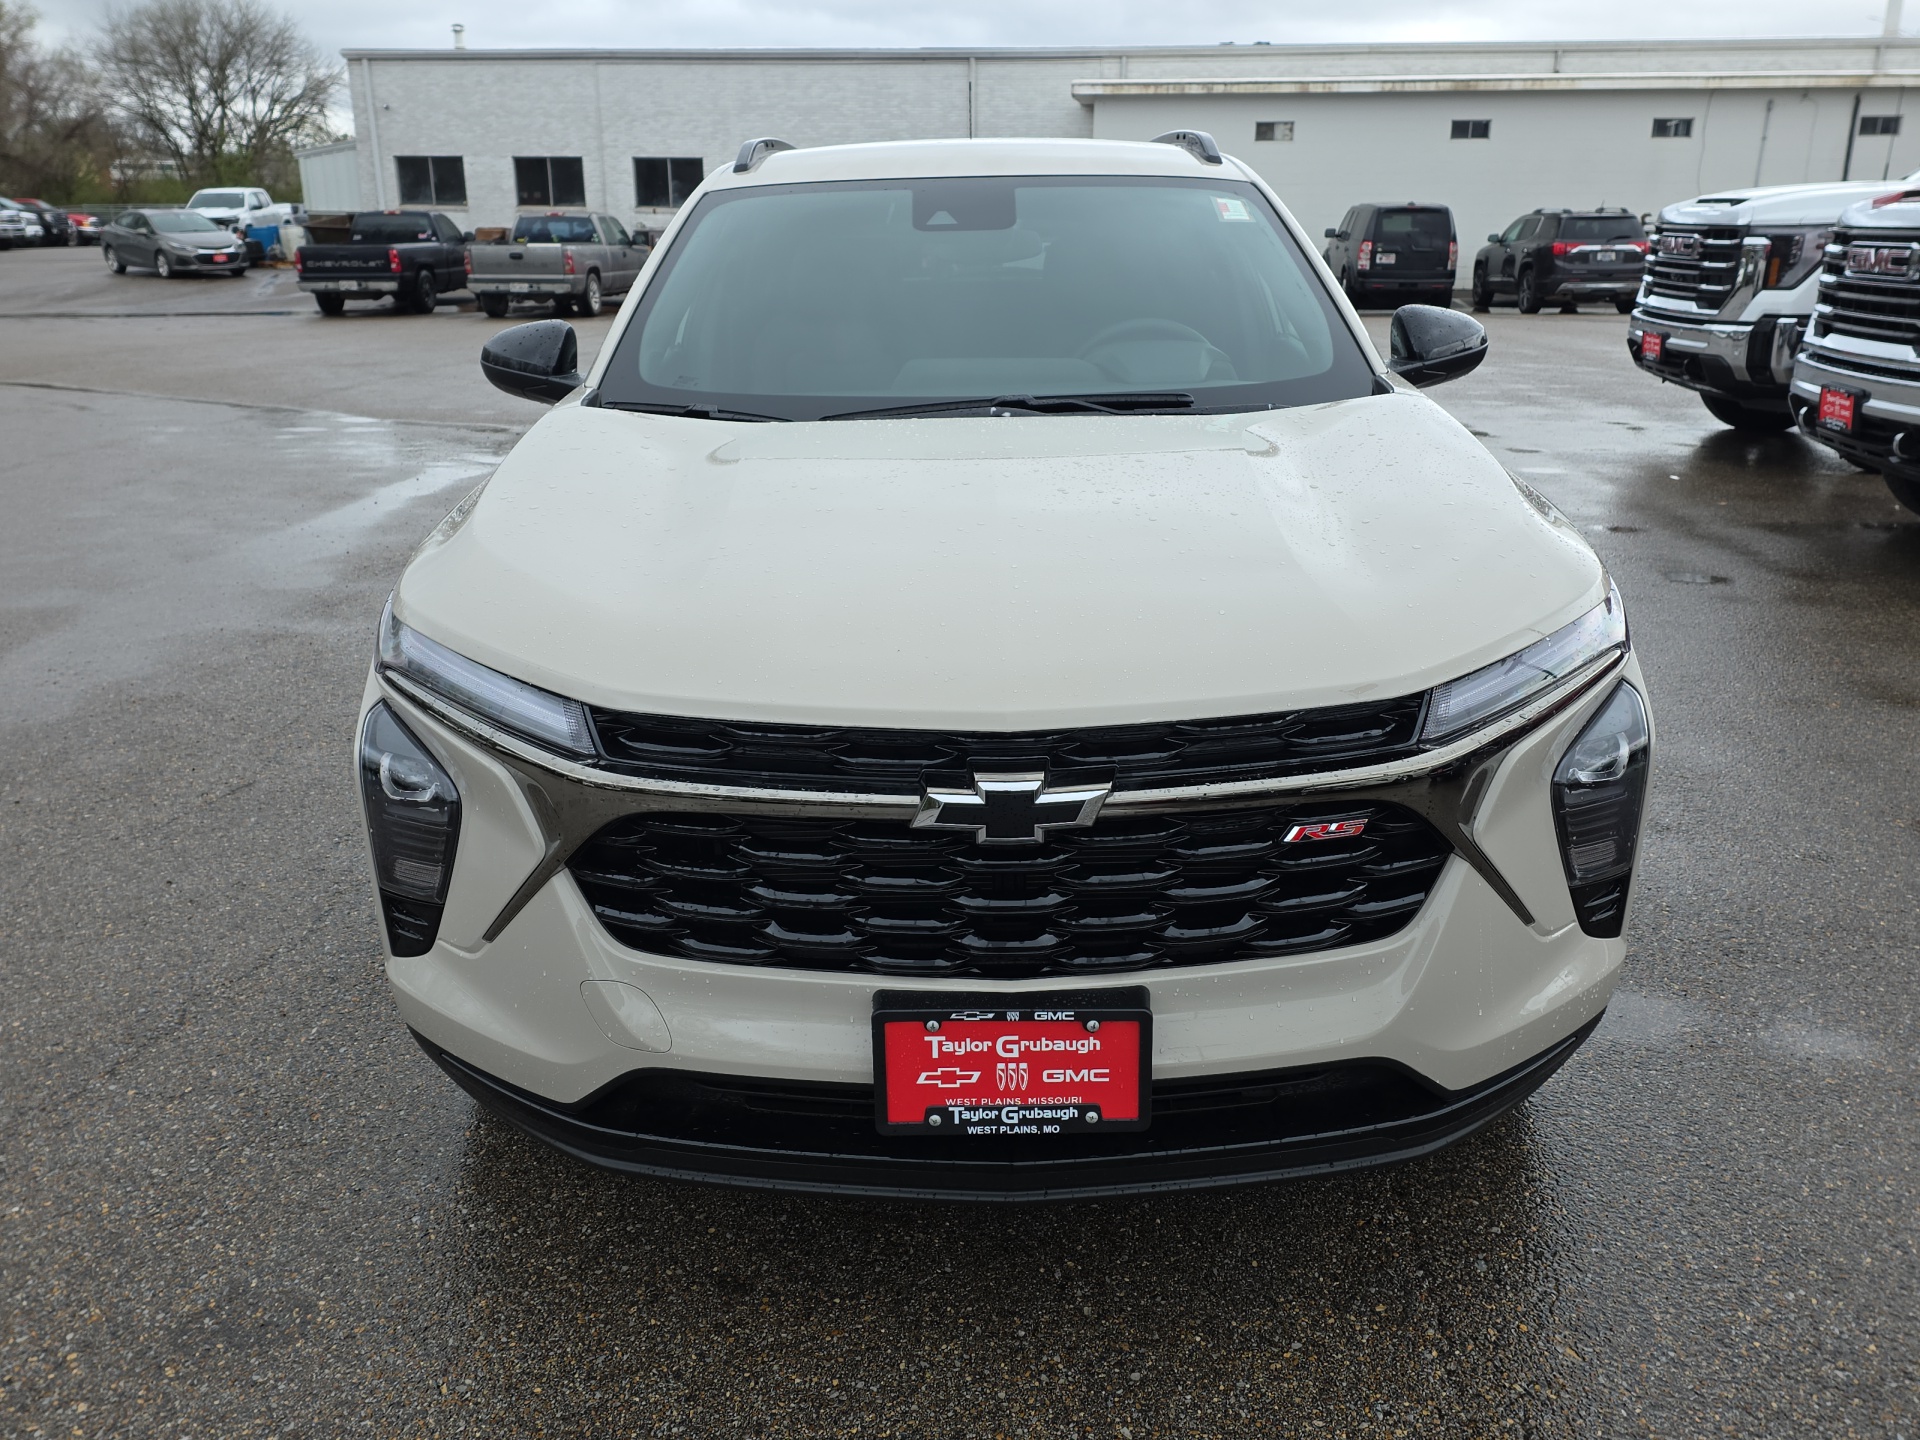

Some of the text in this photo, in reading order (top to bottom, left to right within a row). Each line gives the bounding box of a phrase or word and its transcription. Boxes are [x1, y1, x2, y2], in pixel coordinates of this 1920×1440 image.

[306, 260, 385, 268] CHEVROLET
[1848, 247, 1912, 274] GMC
[1283, 818, 1369, 843] RS
[1034, 1011, 1075, 1021] GMC
[924, 1035, 1101, 1059] Taylor Grubaugh
[1042, 1068, 1110, 1083] GMC
[945, 1098, 977, 1106] WEST
[1028, 1096, 1082, 1105] MISSOURI
[948, 1106, 1078, 1125] Taylor Grubaugh
[967, 1125, 1060, 1135] WEST PLAINS, MO
